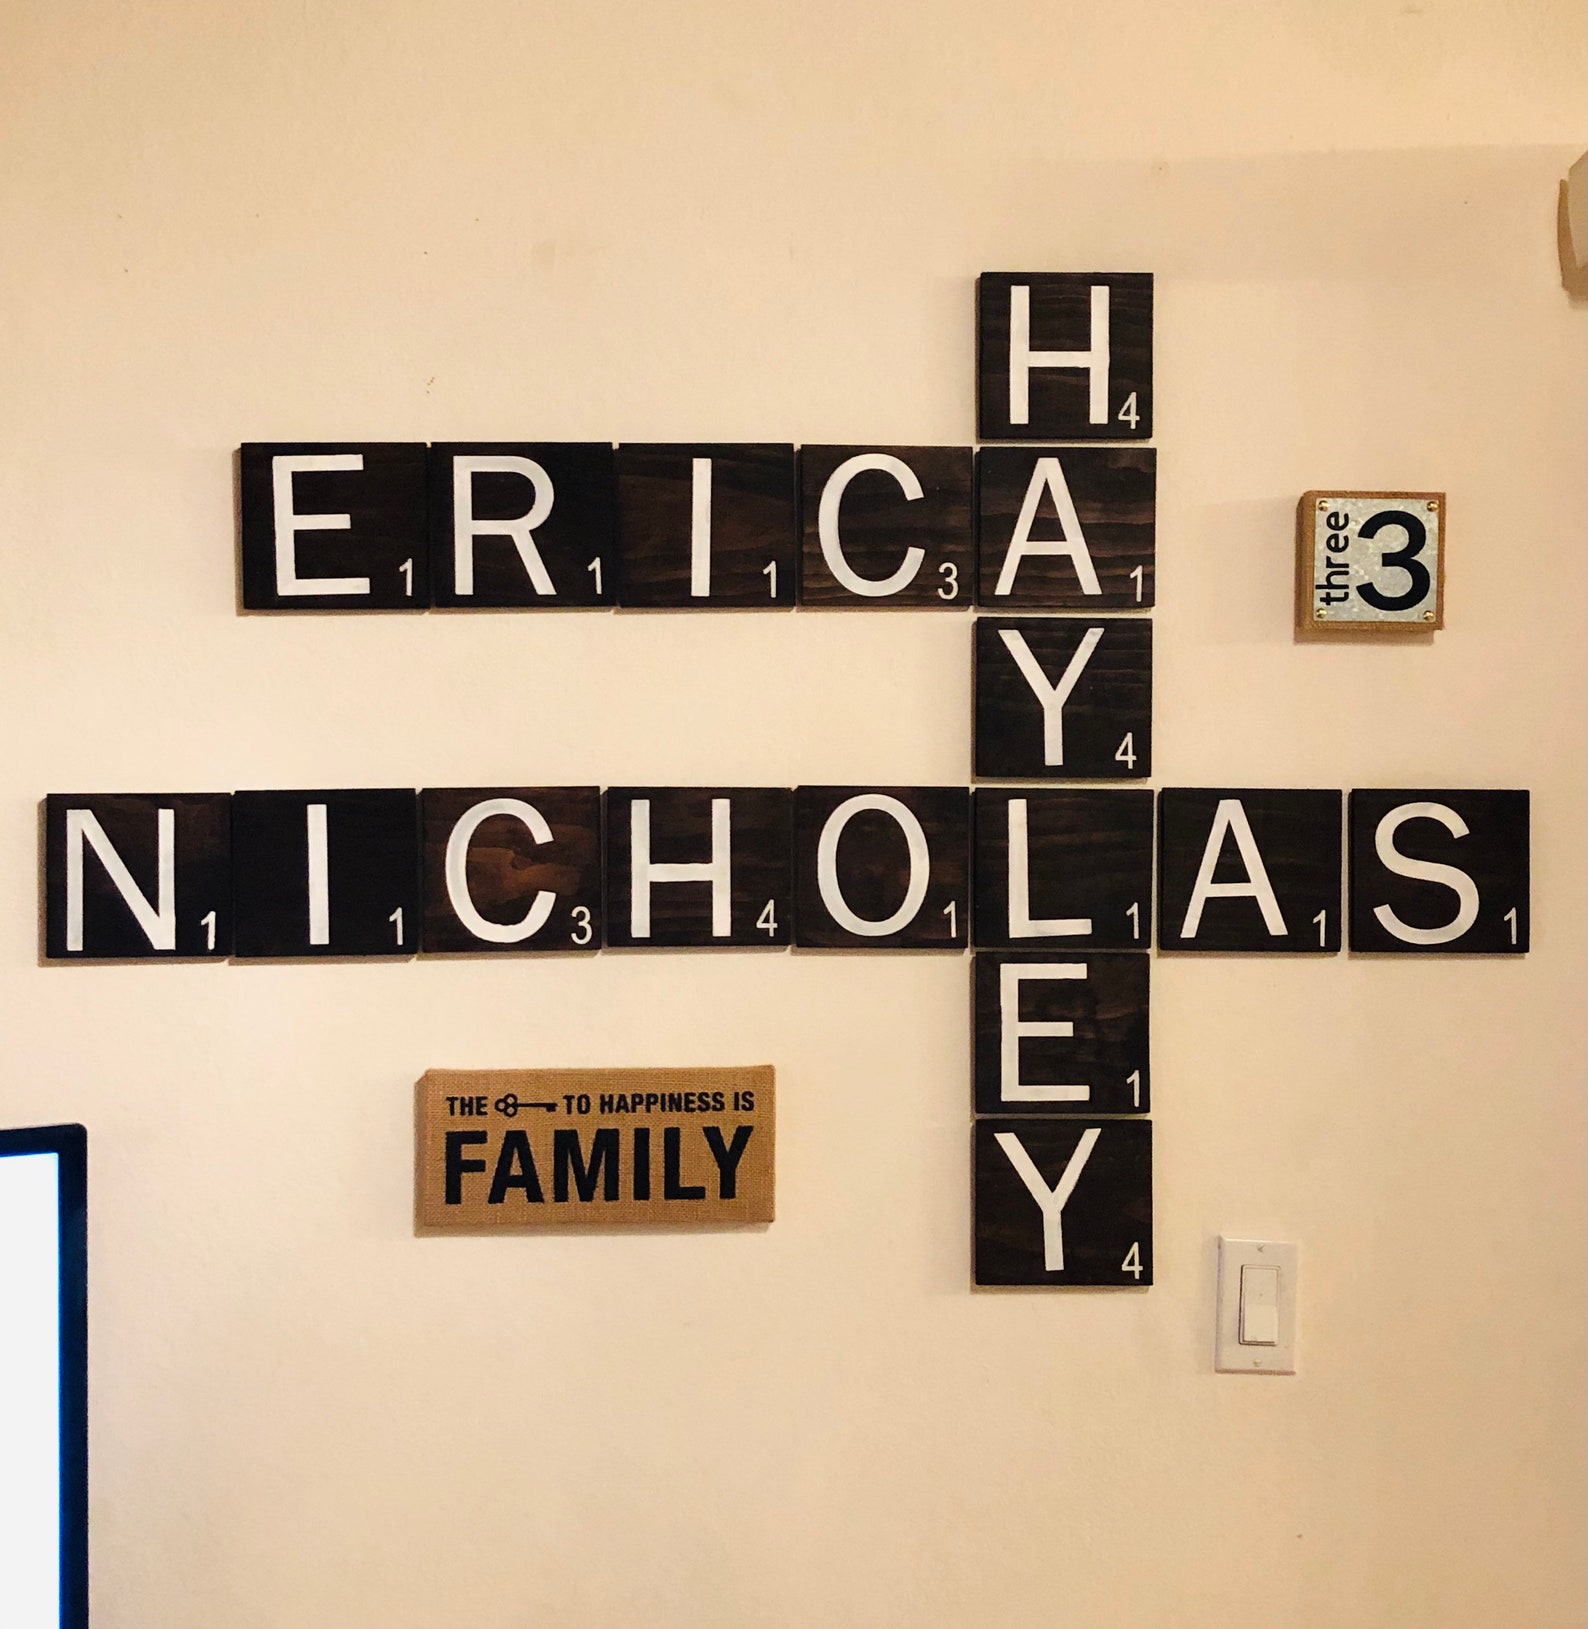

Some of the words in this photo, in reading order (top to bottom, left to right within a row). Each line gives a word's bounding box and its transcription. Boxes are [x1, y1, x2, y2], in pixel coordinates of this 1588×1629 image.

[1117, 391, 1140, 430] 4
[398, 558, 413, 597] 1
[586, 557, 602, 595] 1
[762, 560, 777, 598] 1
[937, 562, 959, 600] 3
[1129, 565, 1143, 602] 1
[1315, 511, 1350, 606] three
[1356, 510, 1431, 611] 3
[1115, 732, 1137, 769] 4
[200, 910, 216, 951] 1
[389, 907, 403, 946] 1
[571, 906, 593, 945] 3
[756, 899, 778, 937] 4
[943, 900, 957, 938] 1
[1126, 902, 1140, 939] 1
[1313, 909, 1326, 947] 1
[1503, 907, 1517, 945] 1
[446, 1095, 488, 1117] THE
[562, 1093, 592, 1115] TO
[599, 1091, 726, 1115] HAPPINESS
[733, 1090, 755, 1112] IS
[1126, 1070, 1140, 1108] 1
[444, 1125, 754, 1205] FAMILY
[1121, 1241, 1143, 1280] 4
